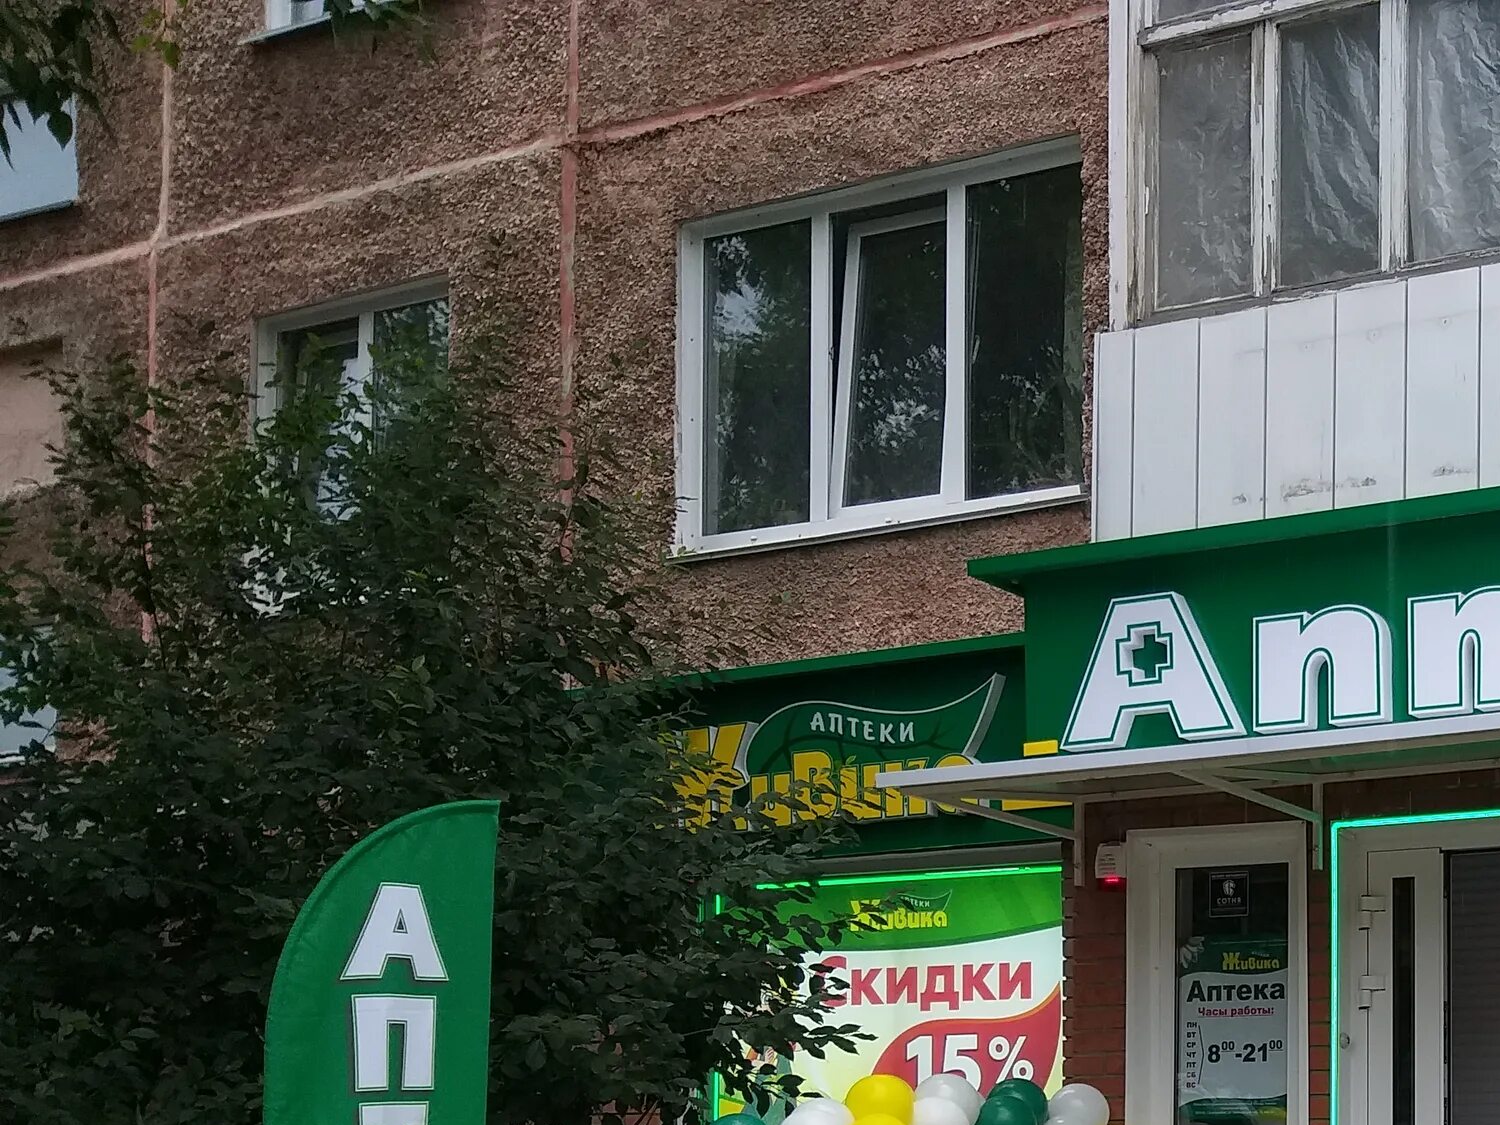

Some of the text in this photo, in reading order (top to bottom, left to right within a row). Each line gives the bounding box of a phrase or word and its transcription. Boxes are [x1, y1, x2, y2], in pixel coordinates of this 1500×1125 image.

[809, 711, 916, 744] АПТЕКИ
[1222, 951, 1280, 971] Живика
[1186, 980, 1286, 1003] Аптека
[1198, 1005, 1275, 1018] Часы работы:
[905, 1033, 1034, 1095] 15%
